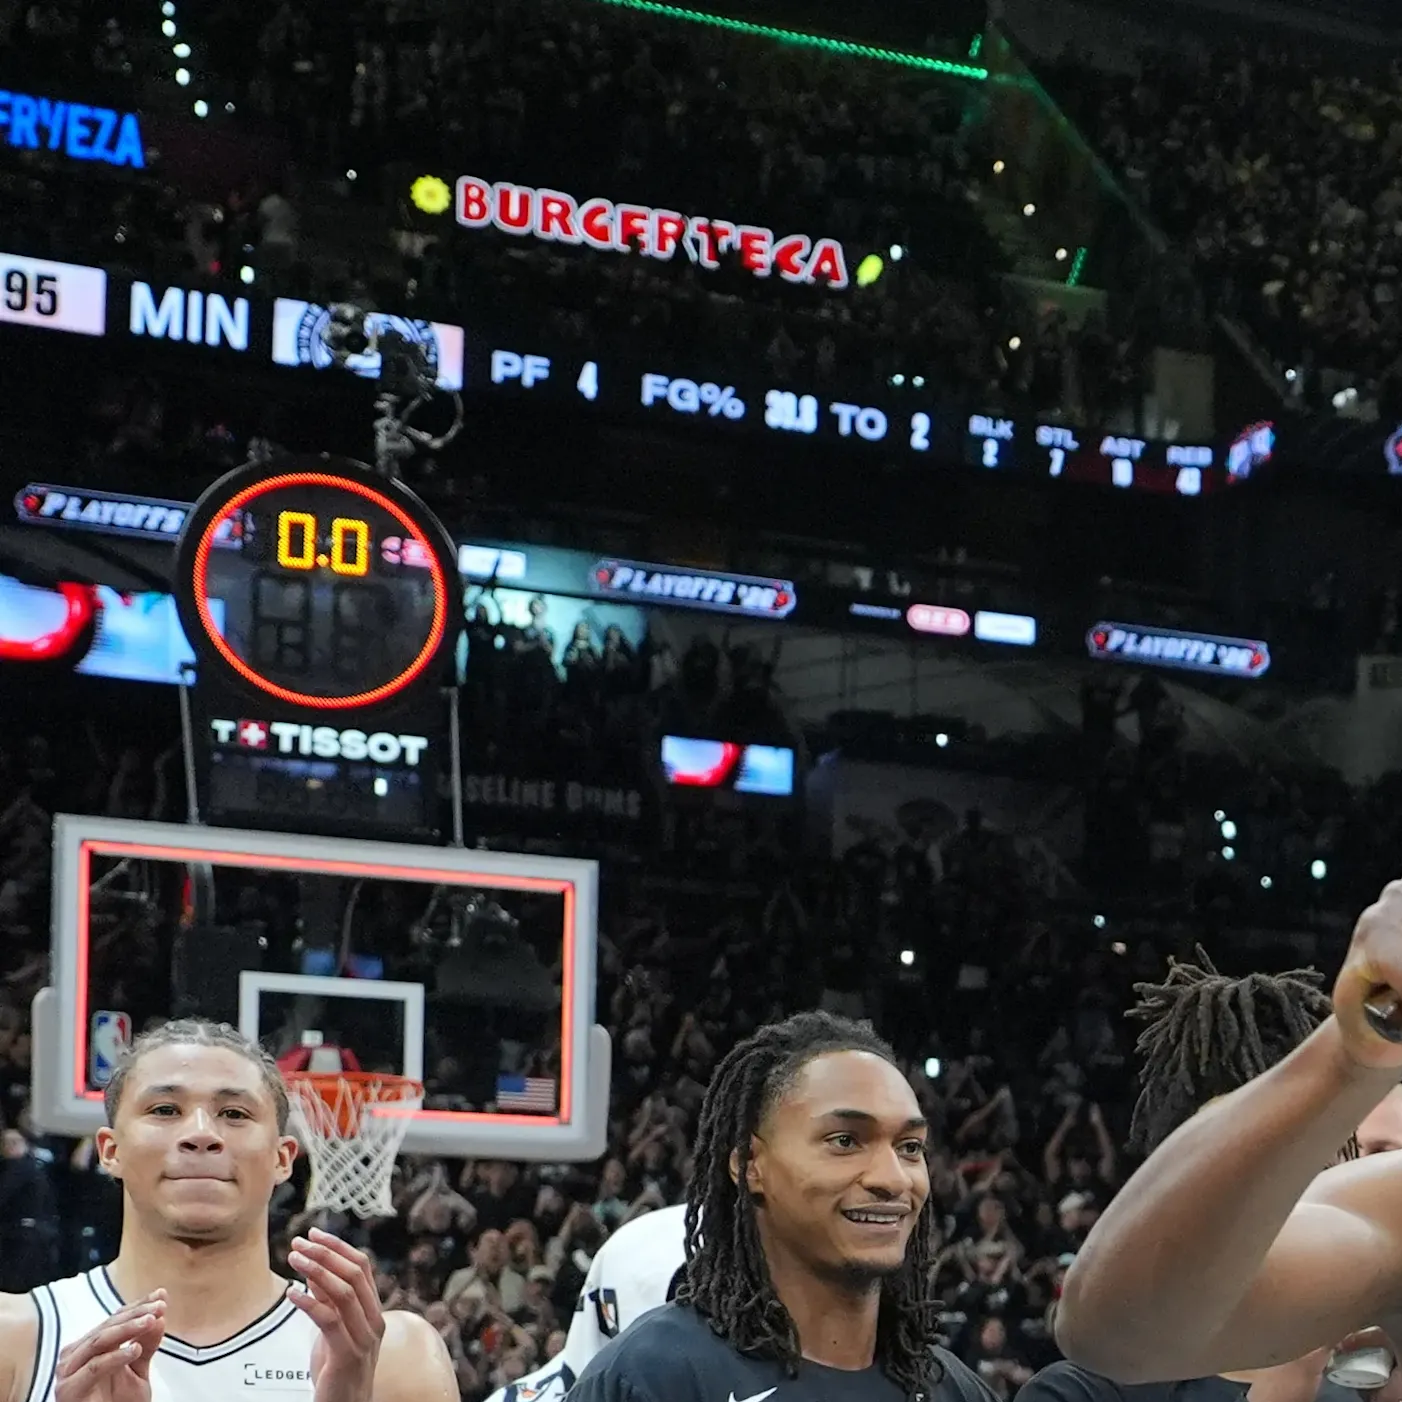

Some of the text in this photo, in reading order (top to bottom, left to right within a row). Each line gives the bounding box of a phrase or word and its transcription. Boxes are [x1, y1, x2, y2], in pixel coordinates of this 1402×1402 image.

[5, 271, 57, 317] 95
[130, 281, 249, 351] MIN
[491, 349, 550, 388] PF
[577, 361, 598, 400] 4
[641, 373, 746, 421] FG%
[829, 402, 888, 441] TO
[910, 412, 930, 451] 2
[39, 492, 186, 533] PLAYOFFS
[277, 510, 369, 577] 0.0
[610, 565, 736, 604] PLAYOFFS
[271, 722, 428, 765] TISSOT
